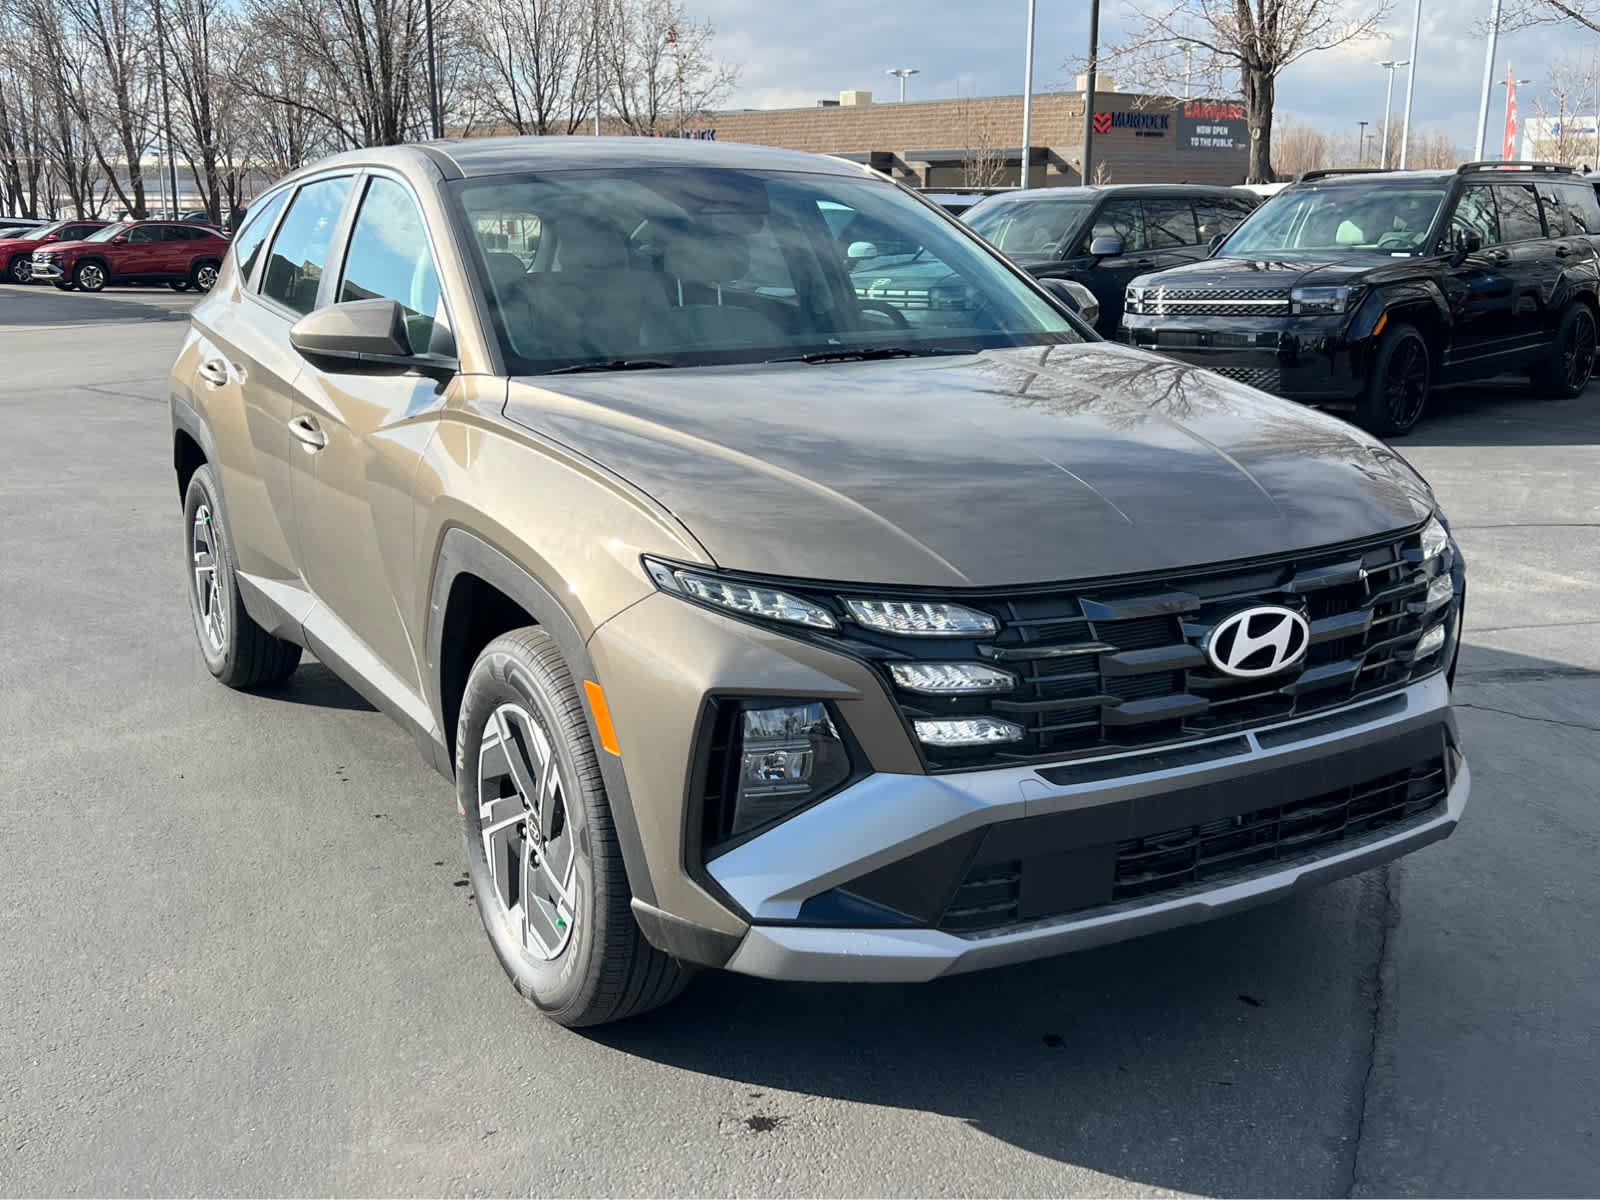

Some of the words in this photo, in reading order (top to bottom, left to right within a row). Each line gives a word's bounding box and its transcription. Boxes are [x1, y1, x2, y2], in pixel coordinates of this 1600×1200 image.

[1111, 112, 1169, 129] MURDOCK
[1196, 125, 1211, 135] NOW
[1212, 125, 1228, 136] OPEN
[1191, 137, 1199, 146] TO
[1200, 137, 1211, 147] THE
[1212, 138, 1233, 148] PUBLIC
